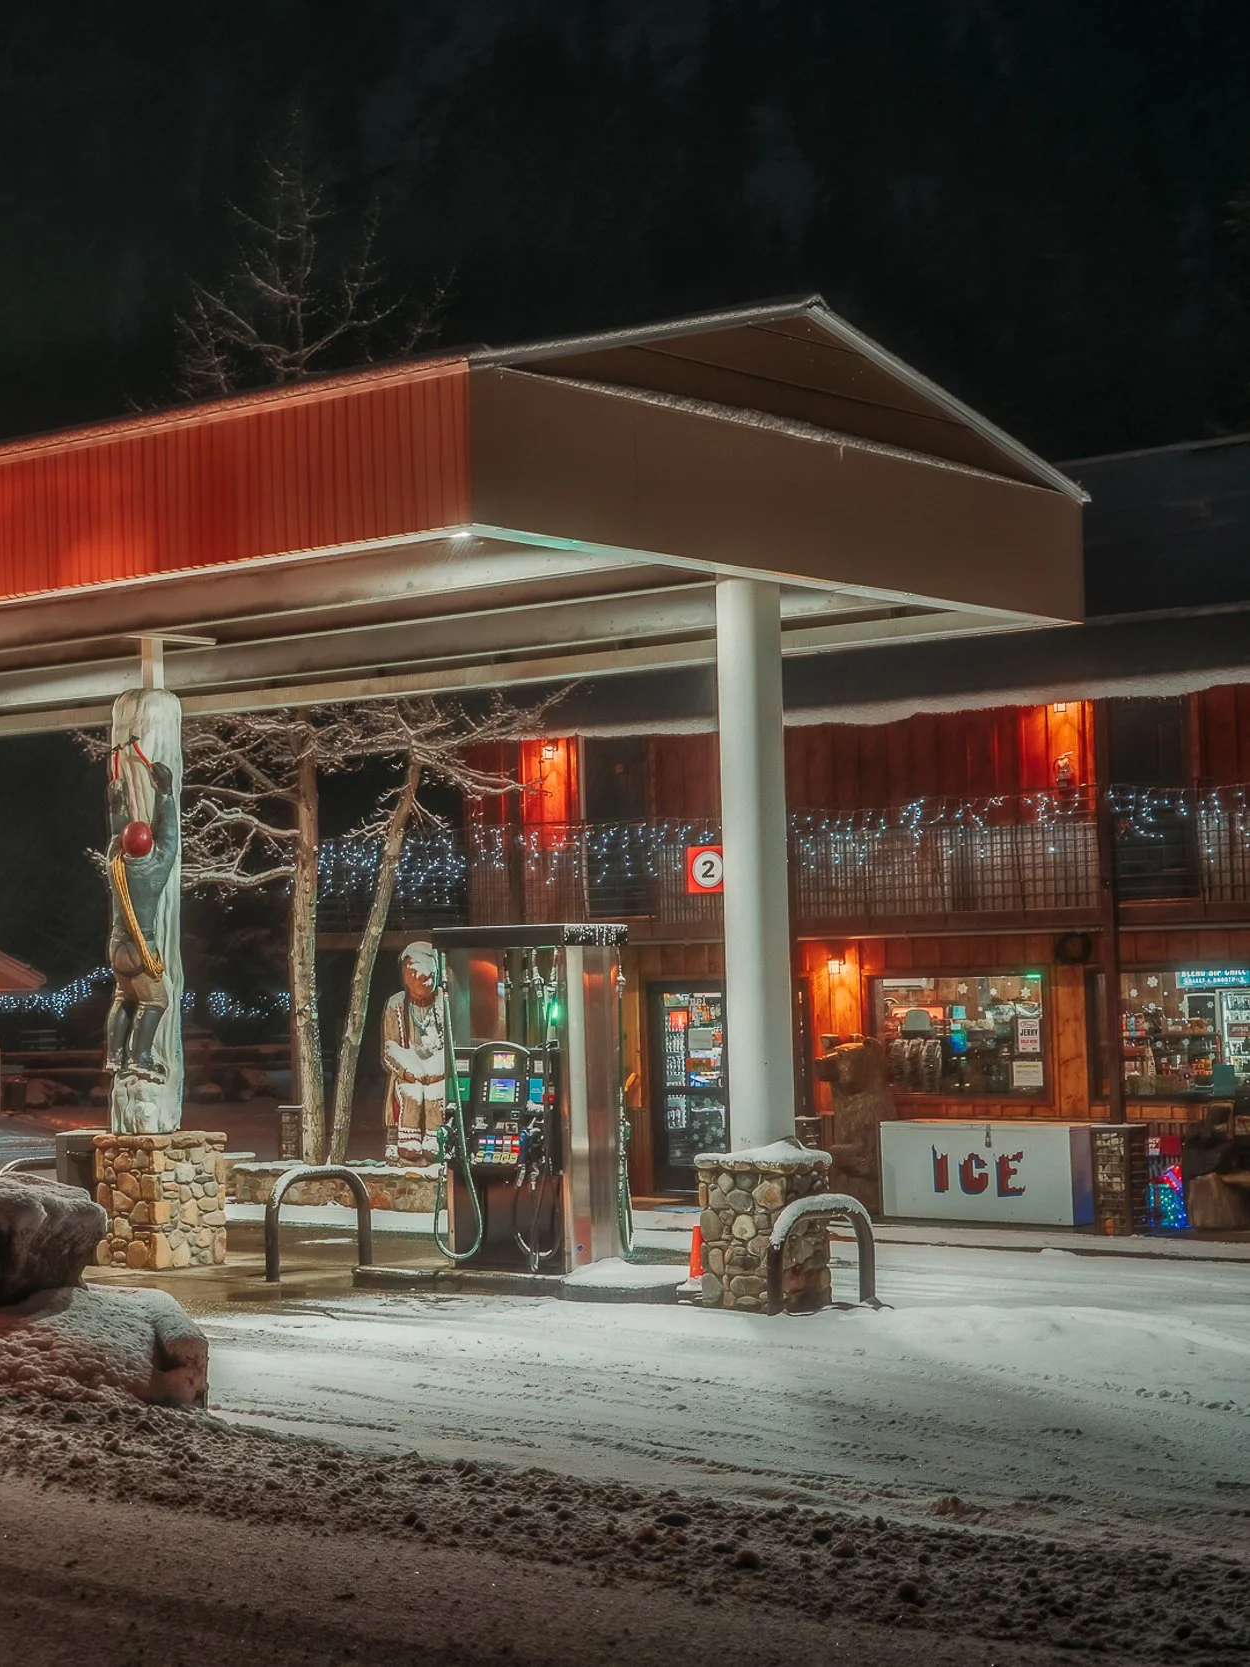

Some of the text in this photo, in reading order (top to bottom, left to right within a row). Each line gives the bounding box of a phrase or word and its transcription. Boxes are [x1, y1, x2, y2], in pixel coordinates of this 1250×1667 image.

[701, 859, 715, 878] 2
[1020, 1028, 1039, 1037] JERKY
[931, 1144, 1026, 1198] ICE
